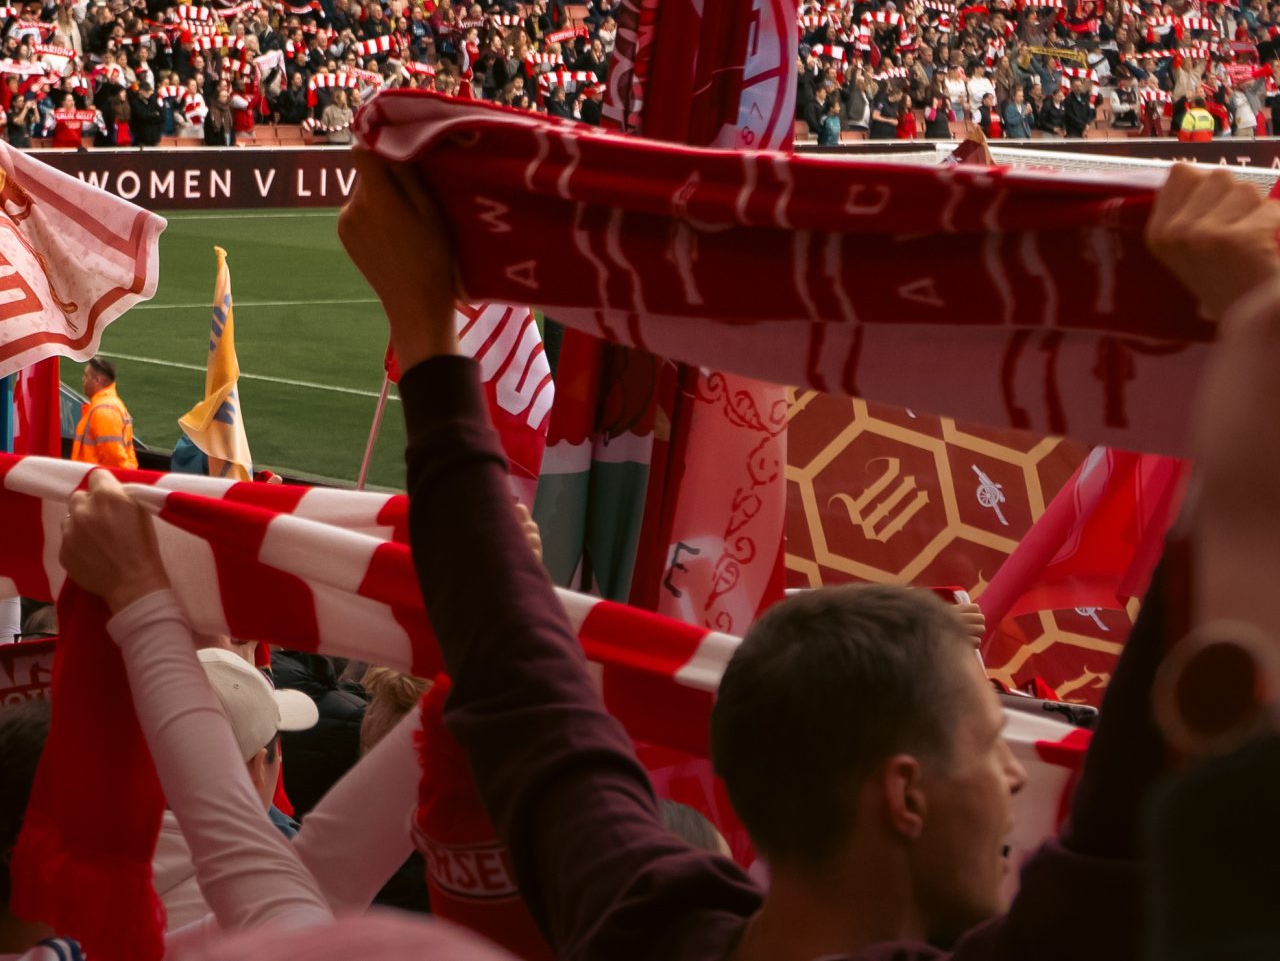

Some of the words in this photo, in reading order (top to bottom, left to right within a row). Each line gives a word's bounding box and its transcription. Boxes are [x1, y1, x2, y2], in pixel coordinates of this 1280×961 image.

[78, 170, 231, 199] WOMEN
[254, 168, 276, 198] V
[297, 168, 357, 197] LIV
